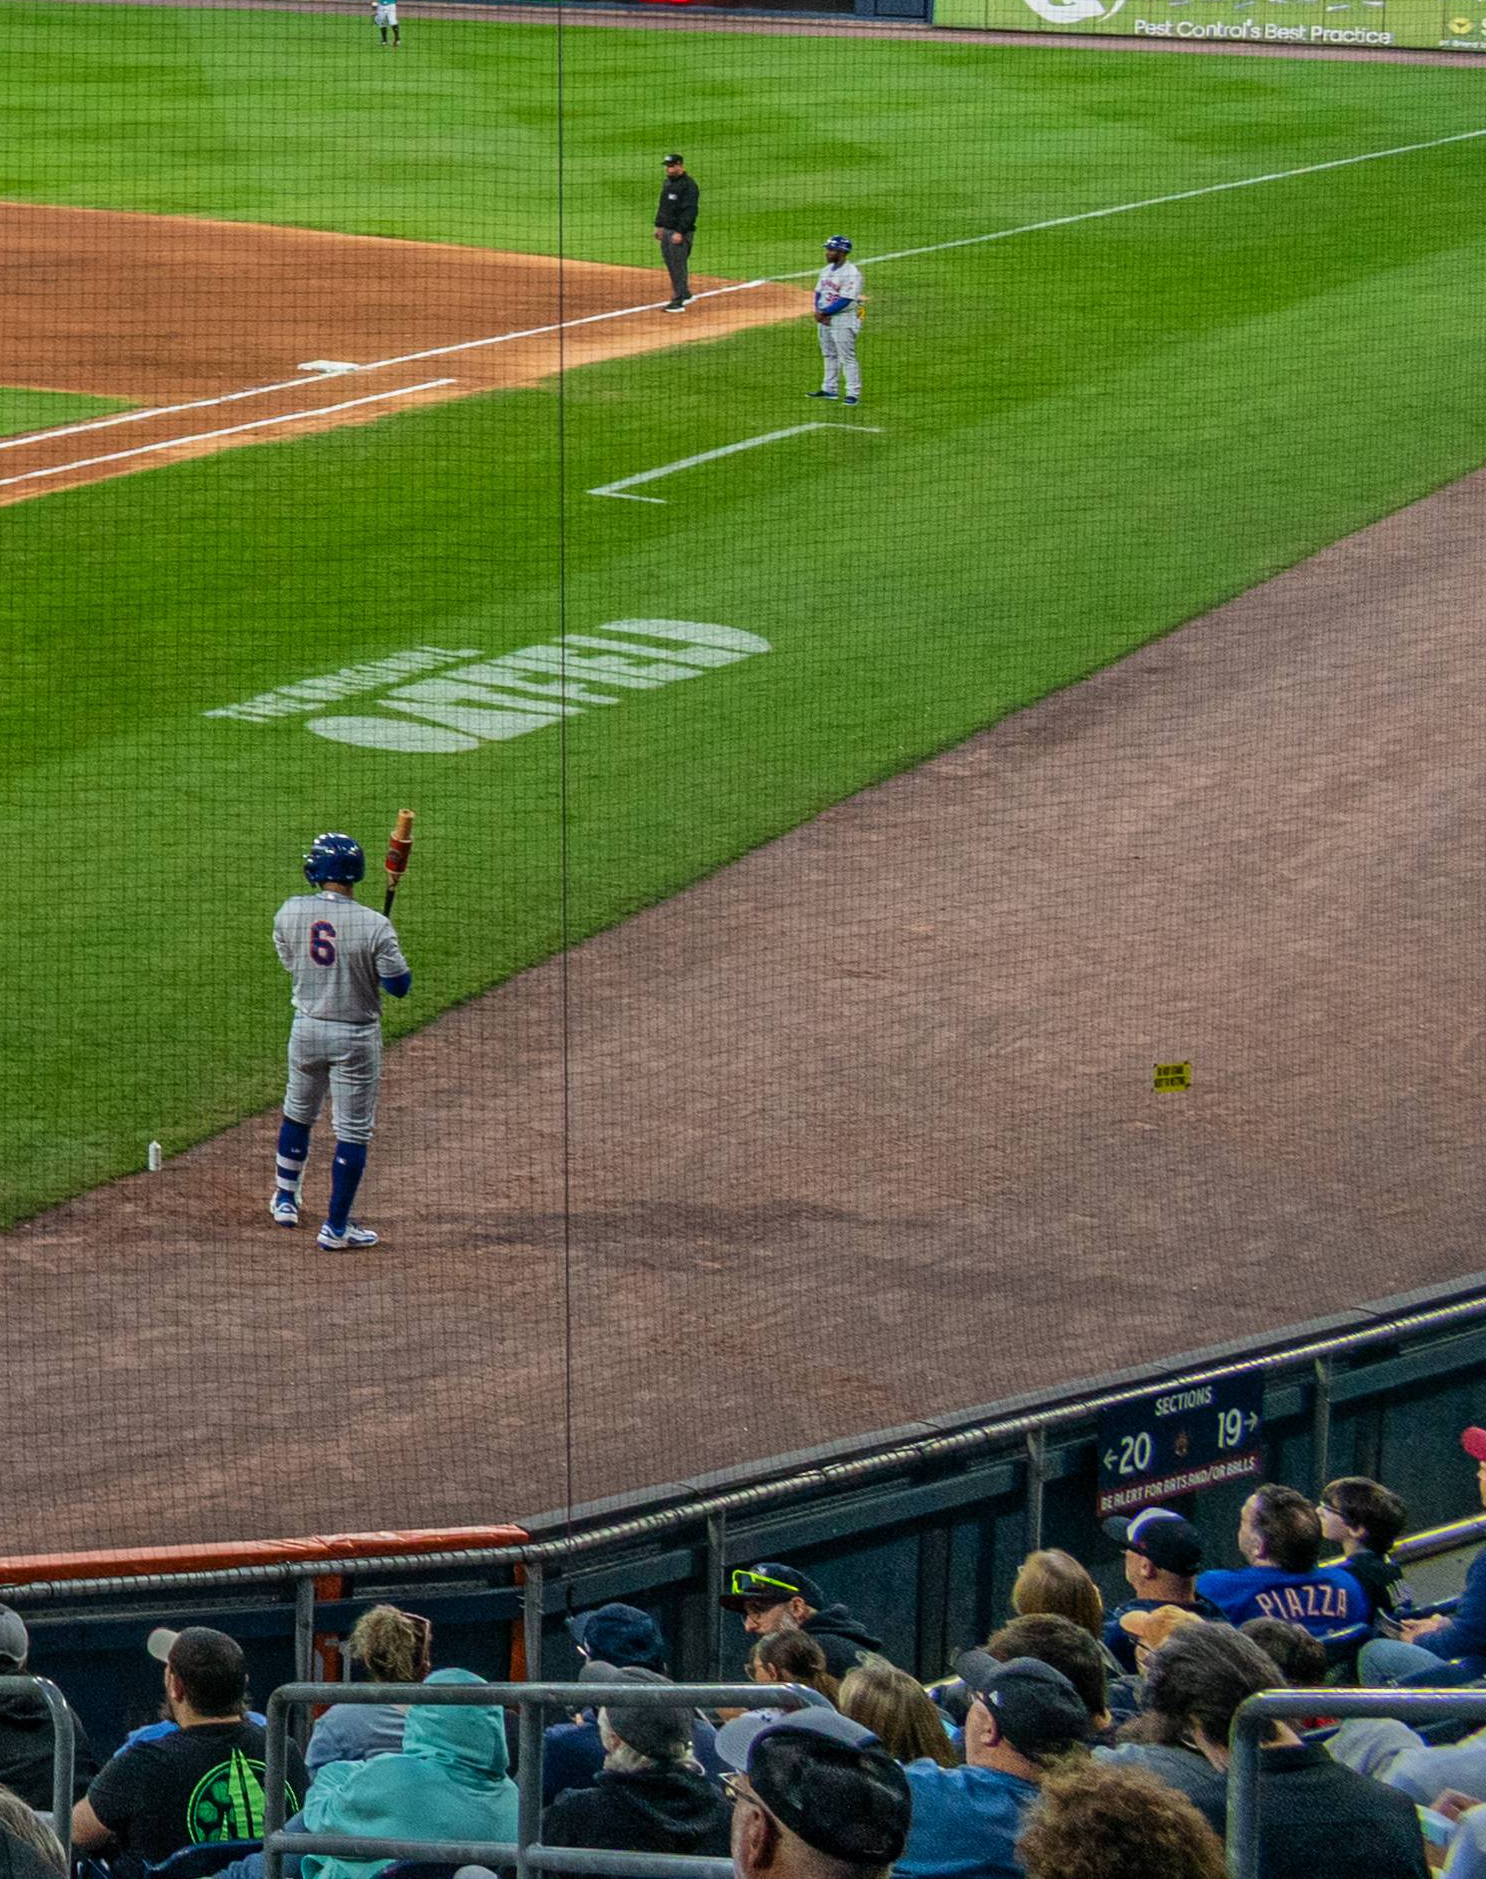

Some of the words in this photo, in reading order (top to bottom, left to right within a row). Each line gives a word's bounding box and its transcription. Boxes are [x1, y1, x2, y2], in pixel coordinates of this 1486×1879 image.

[1133, 20, 1174, 36] Pest
[1176, 19, 1261, 39] Control's
[1264, 23, 1307, 41] Best
[1310, 27, 1392, 45] Practice
[308, 919, 338, 967] 6
[1154, 1384, 1213, 1417] SECTIONS
[1118, 1431, 1153, 1475] 20
[1217, 1407, 1242, 1449] 19
[1255, 1583, 1348, 1620] PIAZZA
